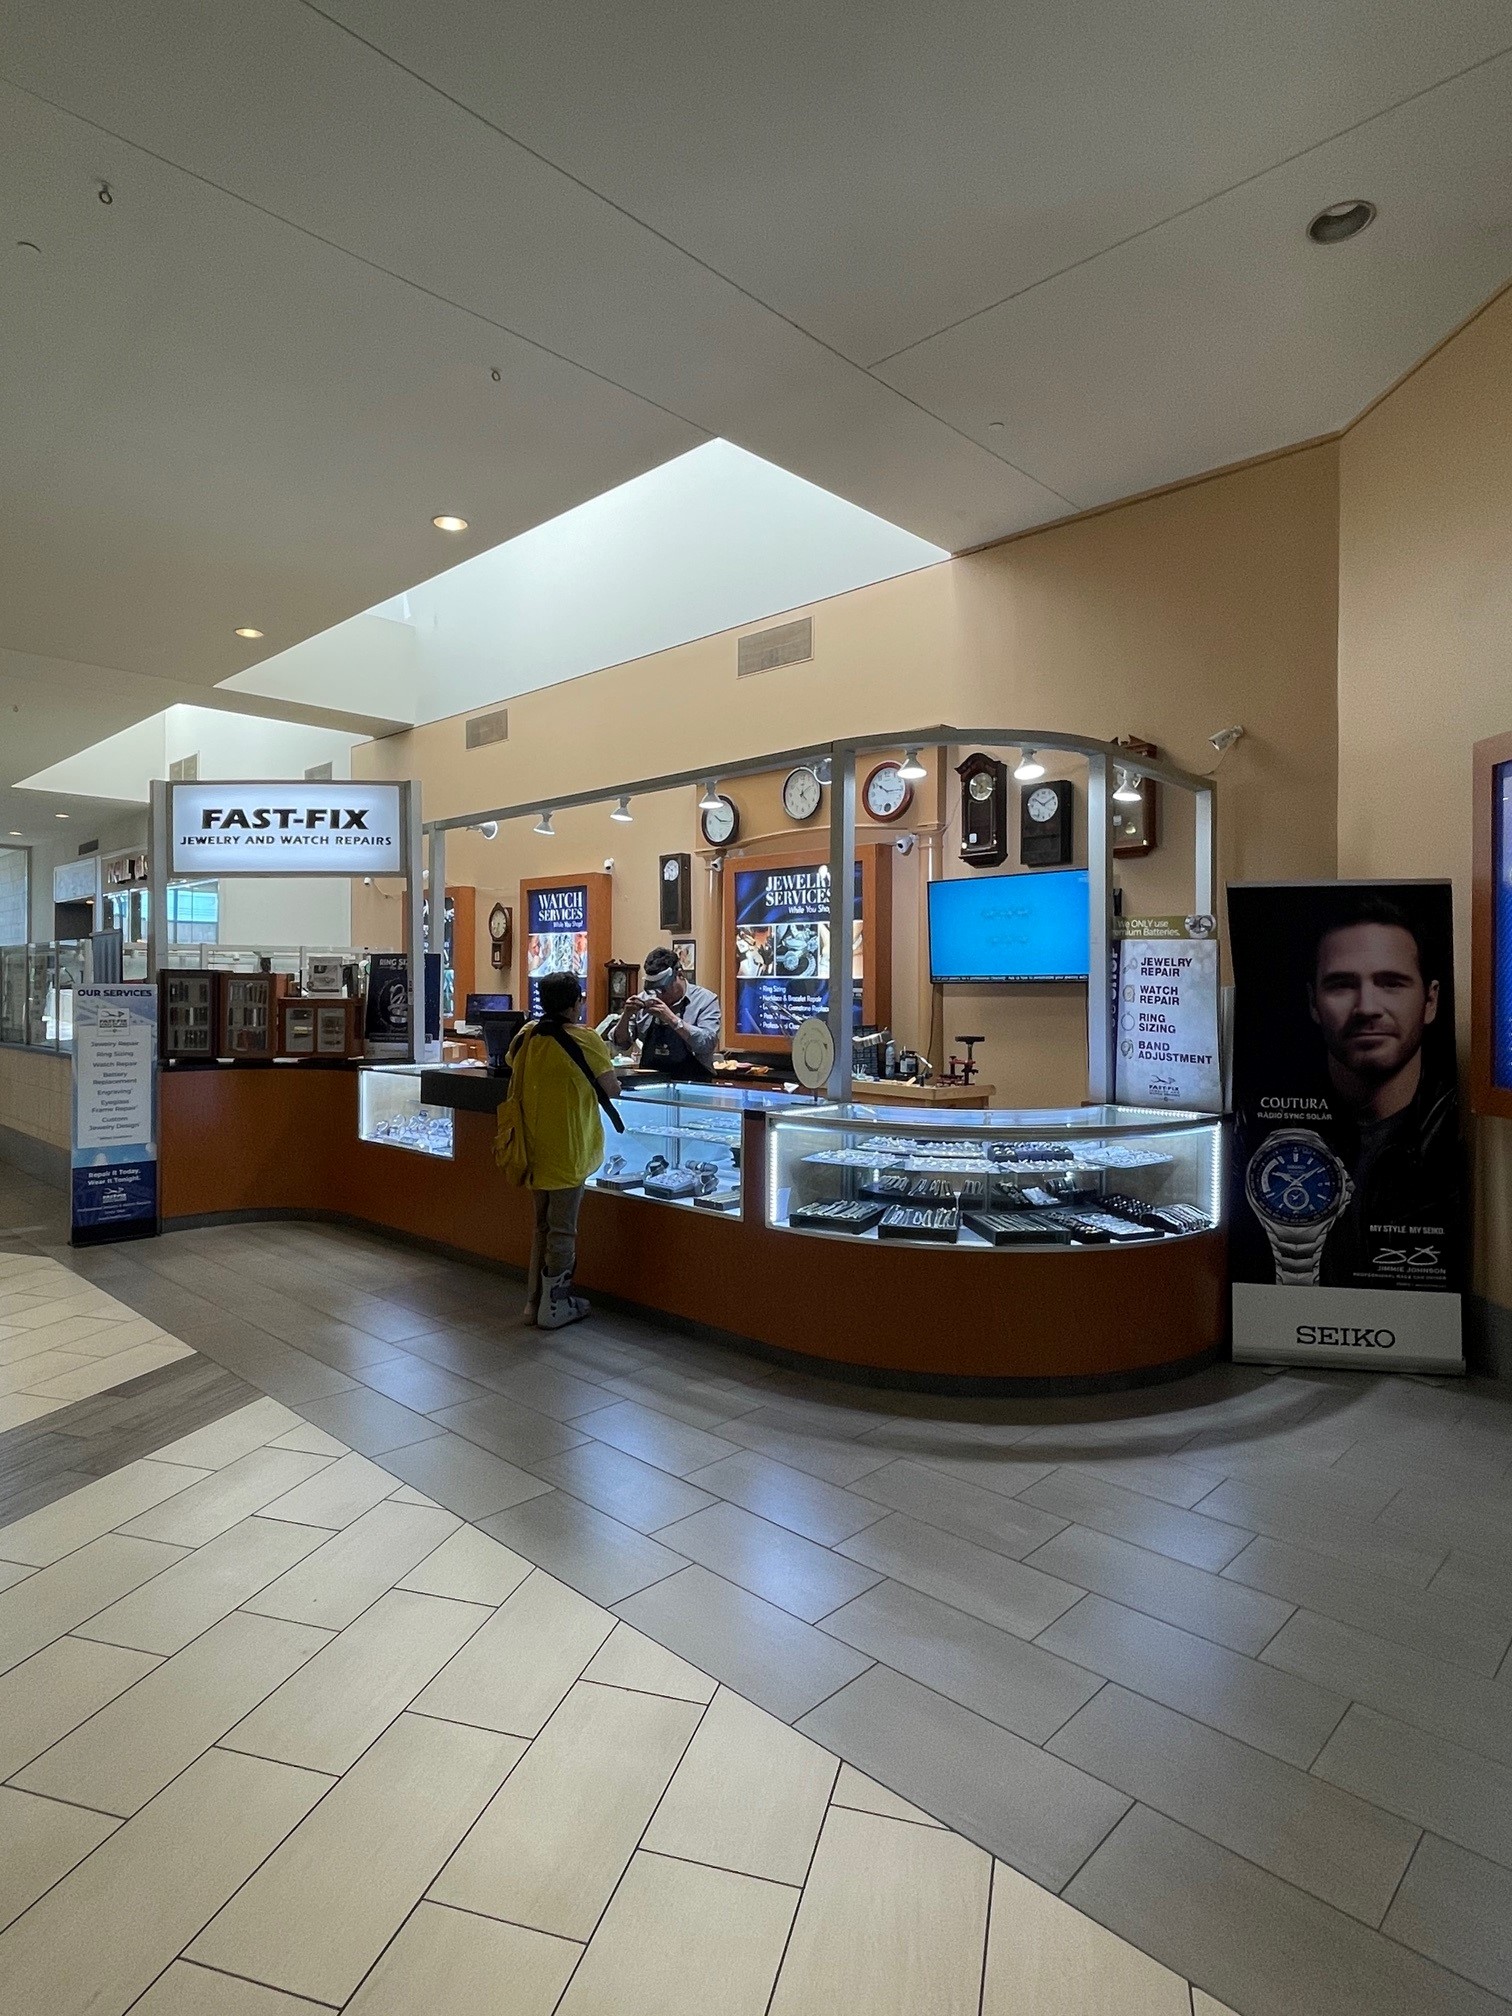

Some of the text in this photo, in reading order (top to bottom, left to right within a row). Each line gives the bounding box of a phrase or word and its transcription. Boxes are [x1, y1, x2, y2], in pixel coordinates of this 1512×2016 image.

[201, 808, 369, 830] FAST-FIX
[180, 835, 392, 846] JEWELRY AND WATCH REPAIRS
[538, 892, 583, 909] WATCH
[788, 904, 831, 914] While You Sho
[538, 908, 583, 921] SERVICES
[1130, 919, 1153, 928] ONLY
[1154, 920, 1169, 928] use
[380, 958, 398, 967] RING
[1140, 957, 1193, 967] JEWELRY
[1140, 967, 1180, 977] REPAIR
[77, 989, 152, 997] OUR SERVICES
[762, 985, 787, 993] Ring Sizing
[1139, 985, 1179, 996] WATCH
[787, 994, 807, 1002] Bracelet
[806, 995, 823, 1003] Repair
[1139, 995, 1180, 1006] REPAIR
[1139, 1013, 1166, 1023] RING
[1138, 1022, 1176, 1034] SIZING
[1138, 1040, 1170, 1052] BAND
[1138, 1050, 1213, 1065] ADJUSTMENT
[1260, 1096, 1329, 1109] COUTURA
[1257, 1111, 1333, 1121] RADIO SYNC SOLAR
[88, 1170, 111, 1179] Repair
[119, 1168, 141, 1176] Today.
[114, 1175, 142, 1183] Tonight.
[1369, 1224, 1382, 1232] MY
[1409, 1226, 1421, 1234] MY
[1377, 1265, 1447, 1275] JIMMIE JOHNSON
[1296, 1325, 1397, 1349] SEIKO
